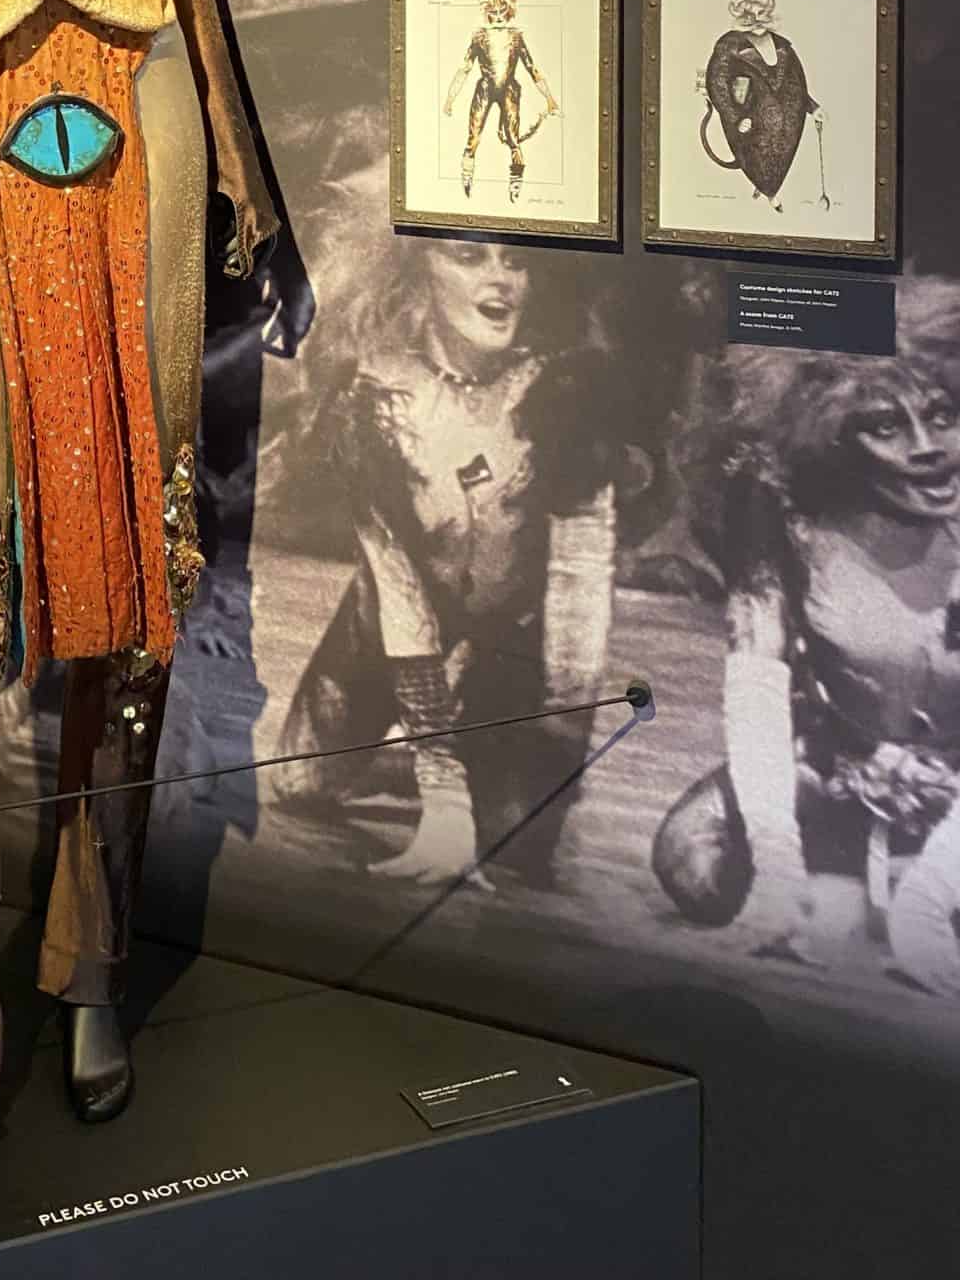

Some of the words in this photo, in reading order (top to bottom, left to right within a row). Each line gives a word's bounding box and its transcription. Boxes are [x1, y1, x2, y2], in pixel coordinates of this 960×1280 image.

[39, 1200, 107, 1226] PLEASE
[110, 1193, 139, 1209] DO
[142, 1182, 182, 1202] NOT
[182, 1166, 249, 1191] TOUCH
